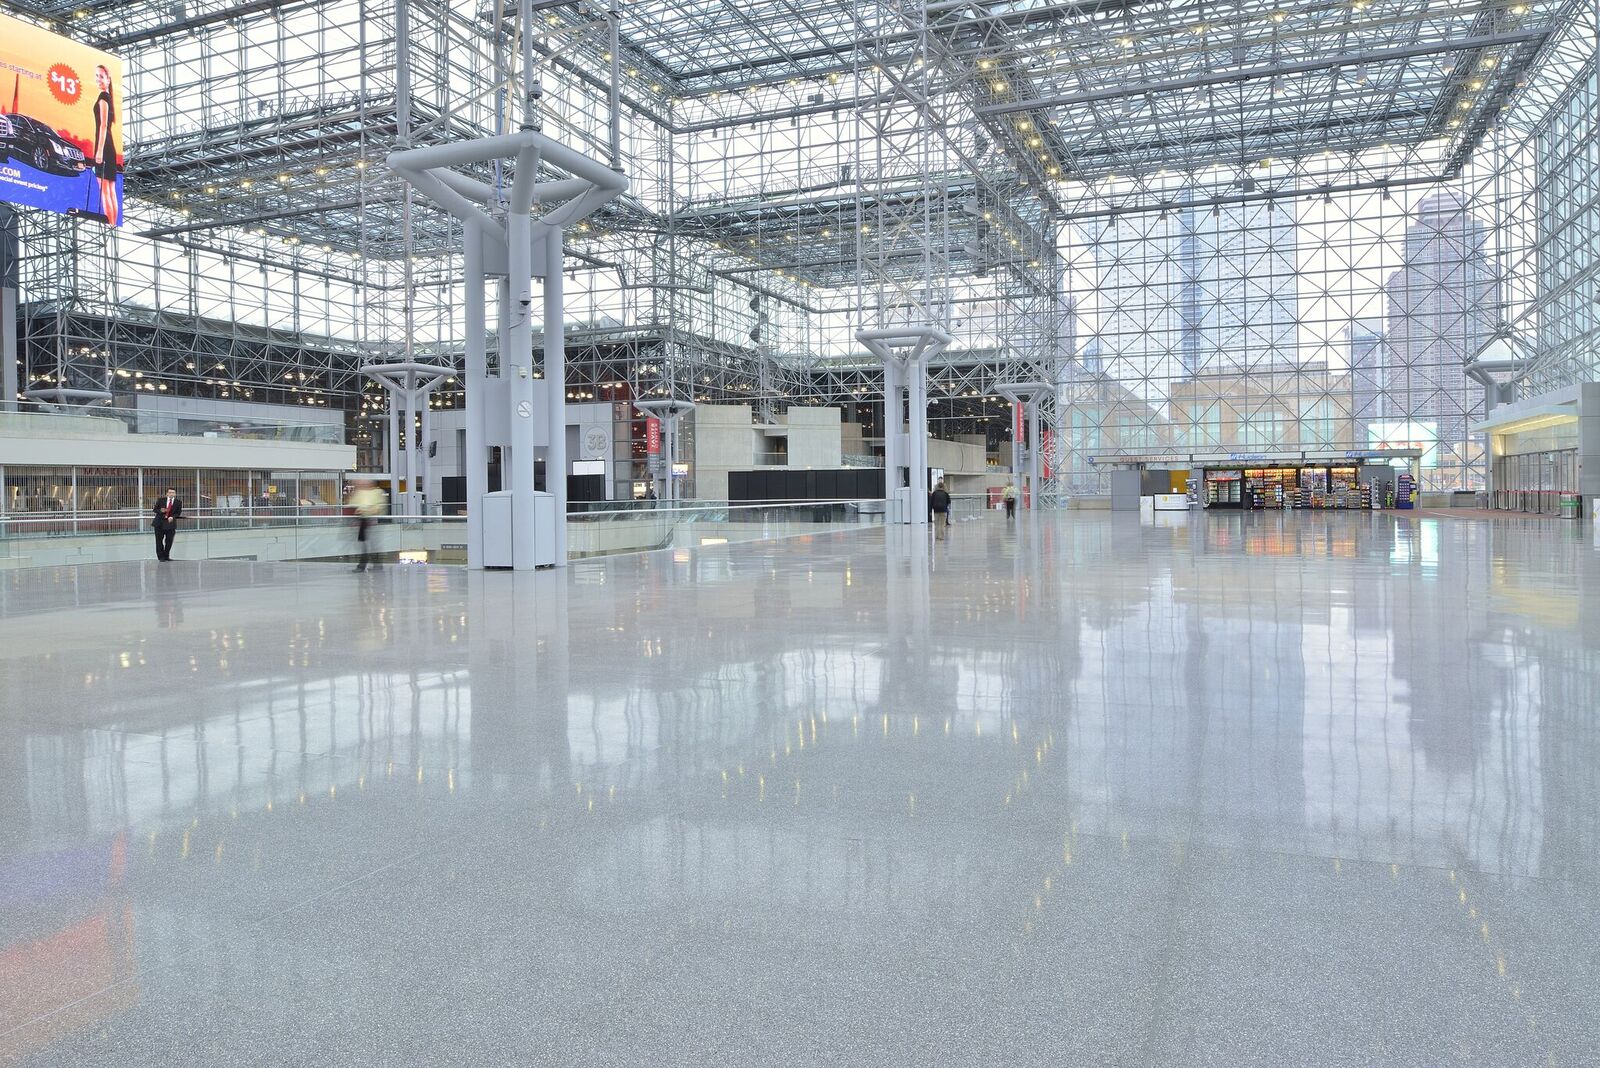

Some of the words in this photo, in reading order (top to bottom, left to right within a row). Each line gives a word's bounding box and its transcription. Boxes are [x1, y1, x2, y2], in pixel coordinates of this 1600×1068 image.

[9, 65, 34, 79] starting
[13, 178, 28, 187] event
[586, 434, 607, 450] 3B
